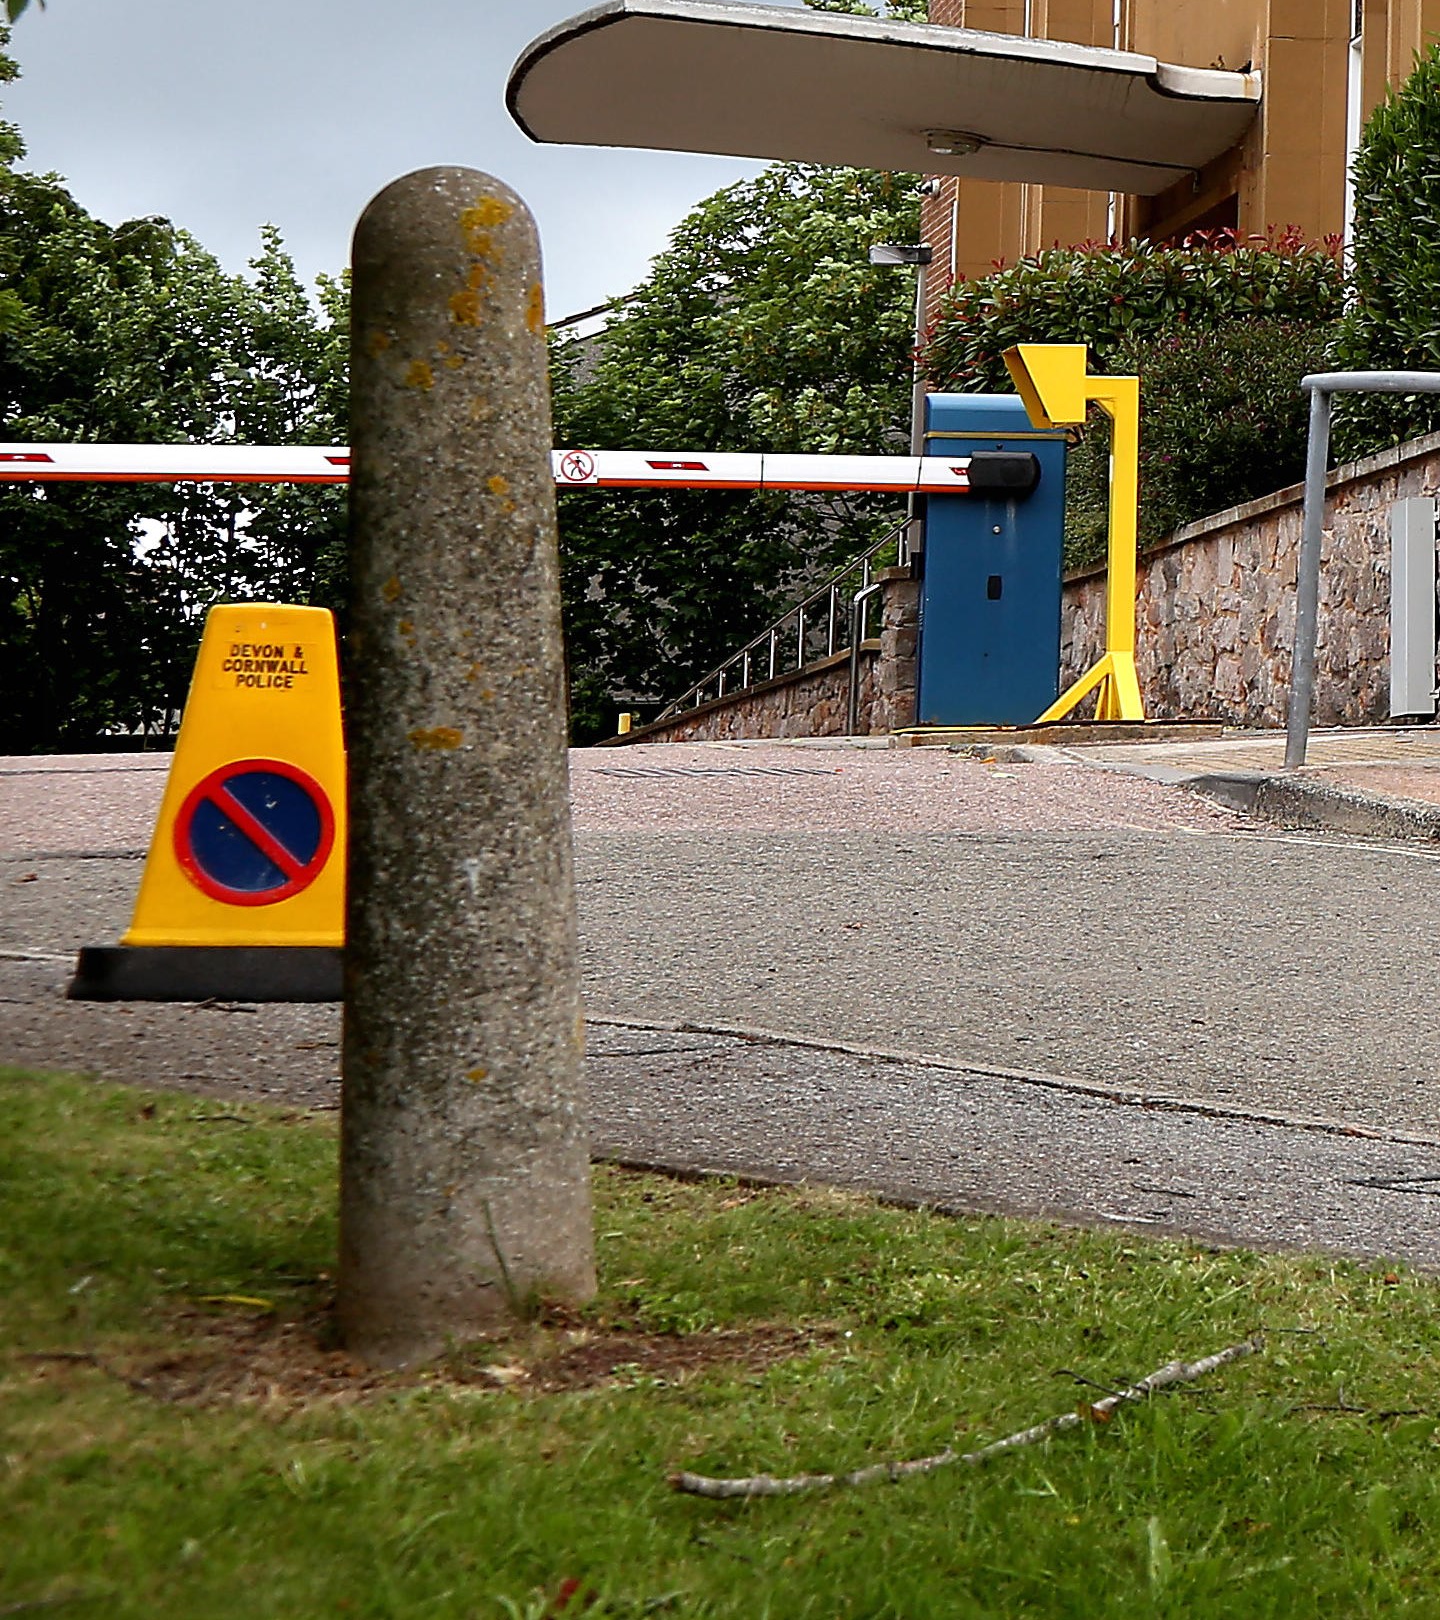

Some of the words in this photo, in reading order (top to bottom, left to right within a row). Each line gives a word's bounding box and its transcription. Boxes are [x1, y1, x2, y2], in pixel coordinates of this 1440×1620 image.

[230, 644, 284, 658] DEVON
[294, 646, 303, 659] &
[222, 659, 308, 674] CORNWALL
[236, 674, 294, 689] POLICE
